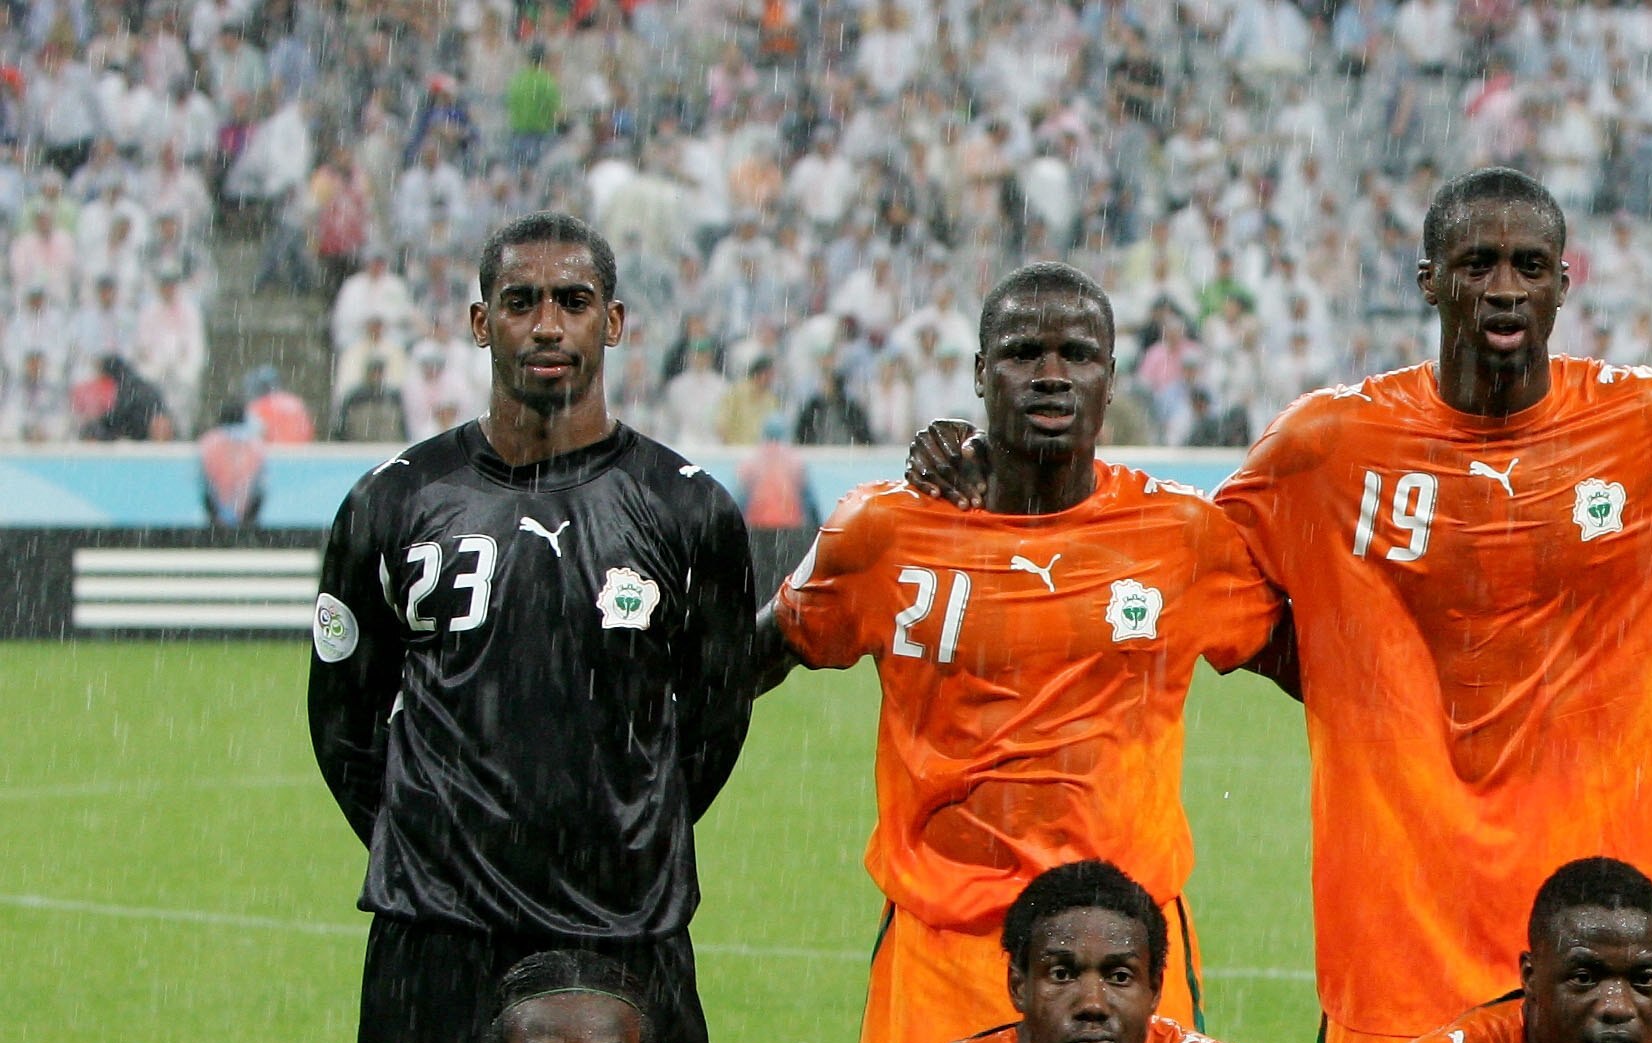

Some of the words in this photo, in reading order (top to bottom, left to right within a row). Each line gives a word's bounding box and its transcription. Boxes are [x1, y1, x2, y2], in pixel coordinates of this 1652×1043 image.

[1352, 470, 1439, 562] 19
[404, 533, 498, 632] 23
[893, 565, 971, 664] 21
